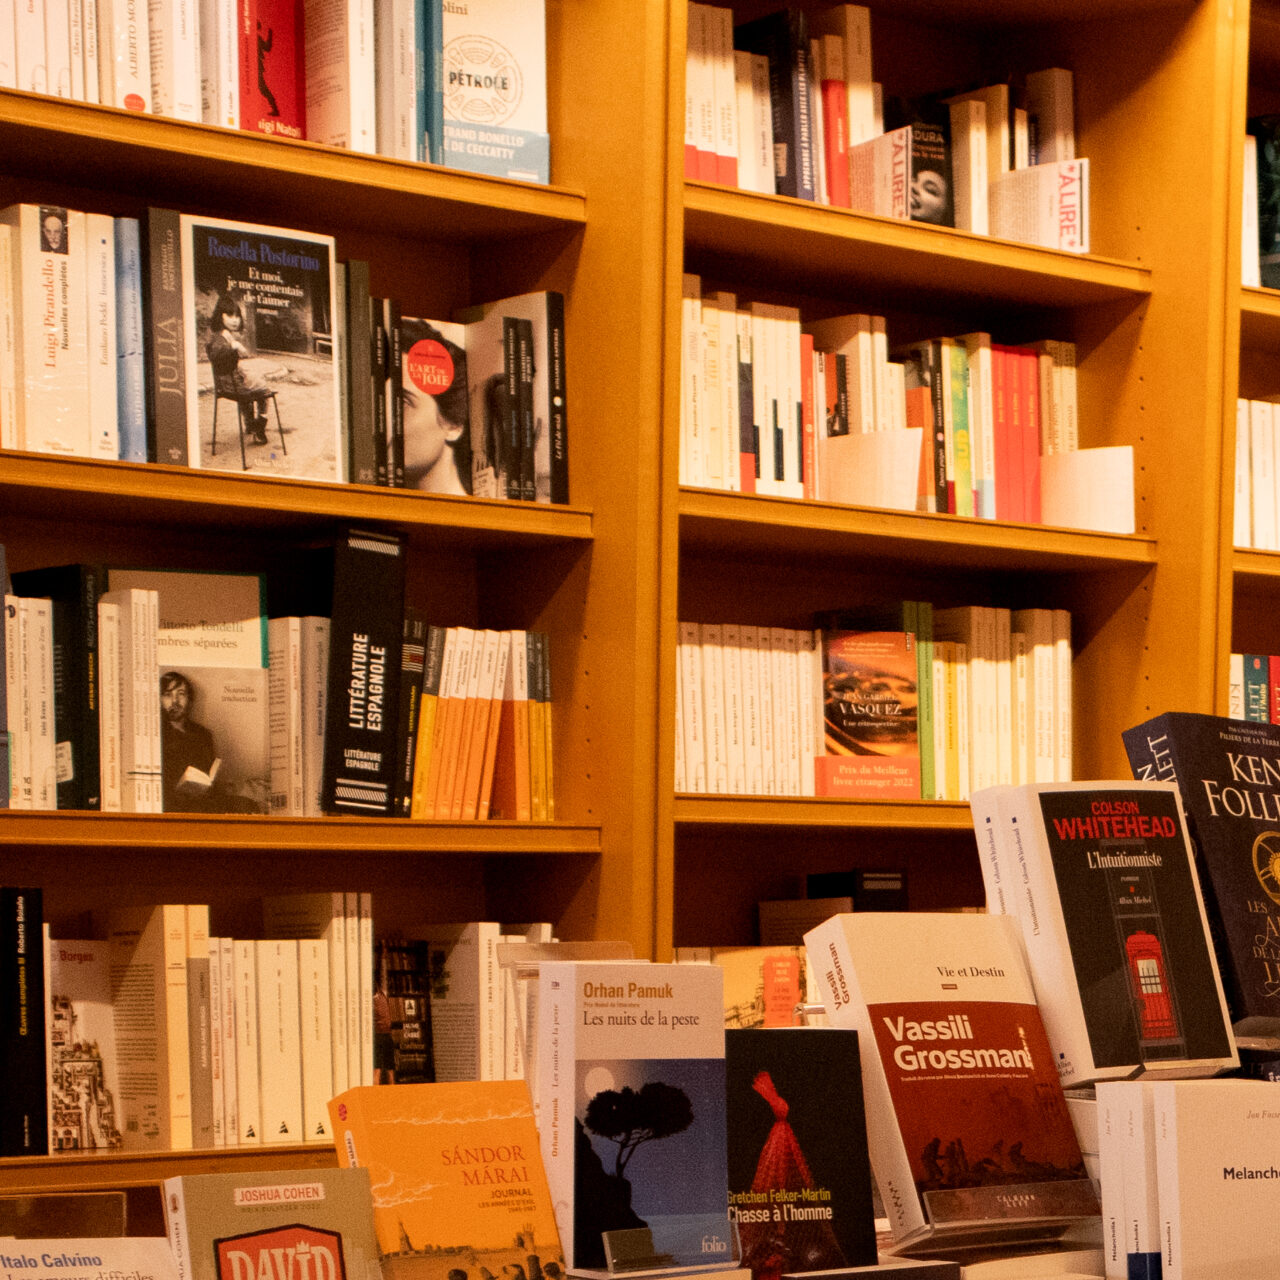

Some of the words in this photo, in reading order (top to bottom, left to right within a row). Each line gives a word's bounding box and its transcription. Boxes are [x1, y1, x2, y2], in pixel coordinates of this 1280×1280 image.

[449, 70, 508, 90] PÉTROLE
[208, 237, 257, 262] Rosella
[260, 244, 320, 271] Postorino
[59, 261, 68, 302] complètes
[249, 267, 259, 279] Et
[261, 271, 283, 284] moi,
[42, 258, 54, 326] Pirandello
[227, 275, 236, 291] je
[238, 280, 253, 291] me
[254, 281, 304, 297] contentais
[243, 291, 255, 303] de
[256, 293, 290, 308] t'aimer
[60, 303, 69, 350] Nouvelles
[44, 328, 56, 368] Luigi
[349, 632, 368, 729] LITTÉRATURE
[367, 646, 386, 731] ESPAGNOLE
[344, 748, 382, 762] LITTÉRATURE
[345, 759, 380, 772] ESPAGNOLE
[839, 765, 857, 774] Prix
[859, 765, 870, 774] du
[874, 765, 909, 775] Meilleur
[834, 777, 852, 786] livre
[856, 778, 890, 788] étranger
[893, 778, 913, 787] 2022
[1091, 801, 1140, 816] COLSON
[1053, 815, 1176, 841] WHITEHEAD
[1088, 851, 1162, 869] L'Intuitionniste
[16, 896, 24, 924] Bolaño
[1248, 901, 1267, 915] LES
[1253, 945, 1268, 960] DE
[936, 965, 954, 979] Vie
[956, 968, 967, 978] et
[970, 965, 1005, 980] Destin
[584, 982, 623, 999] Orhan
[628, 983, 673, 998] Pamuk
[583, 1010, 604, 1026] Les
[608, 1011, 638, 1026] nuits
[641, 1011, 655, 1026] de
[658, 1011, 668, 1026] la
[671, 1013, 699, 1030] peste
[883, 1014, 974, 1043] Vassili
[893, 1046, 1027, 1072] Grossman
[441, 1145, 525, 1166] SÁNDOR
[462, 1166, 530, 1185] MÁRAI
[239, 1188, 278, 1203] JOSHUA
[282, 1186, 320, 1201] COHEN
[489, 1188, 534, 1198] JOURNAL
[769, 1188, 831, 1204] Felker-Martin
[727, 1207, 768, 1223] Chasse
[773, 1207, 781, 1221] à
[784, 1205, 833, 1222] l'homme
[701, 1234, 727, 1254] folio
[1, 1253, 37, 1270] Italo
[41, 1252, 102, 1269] Calvino
